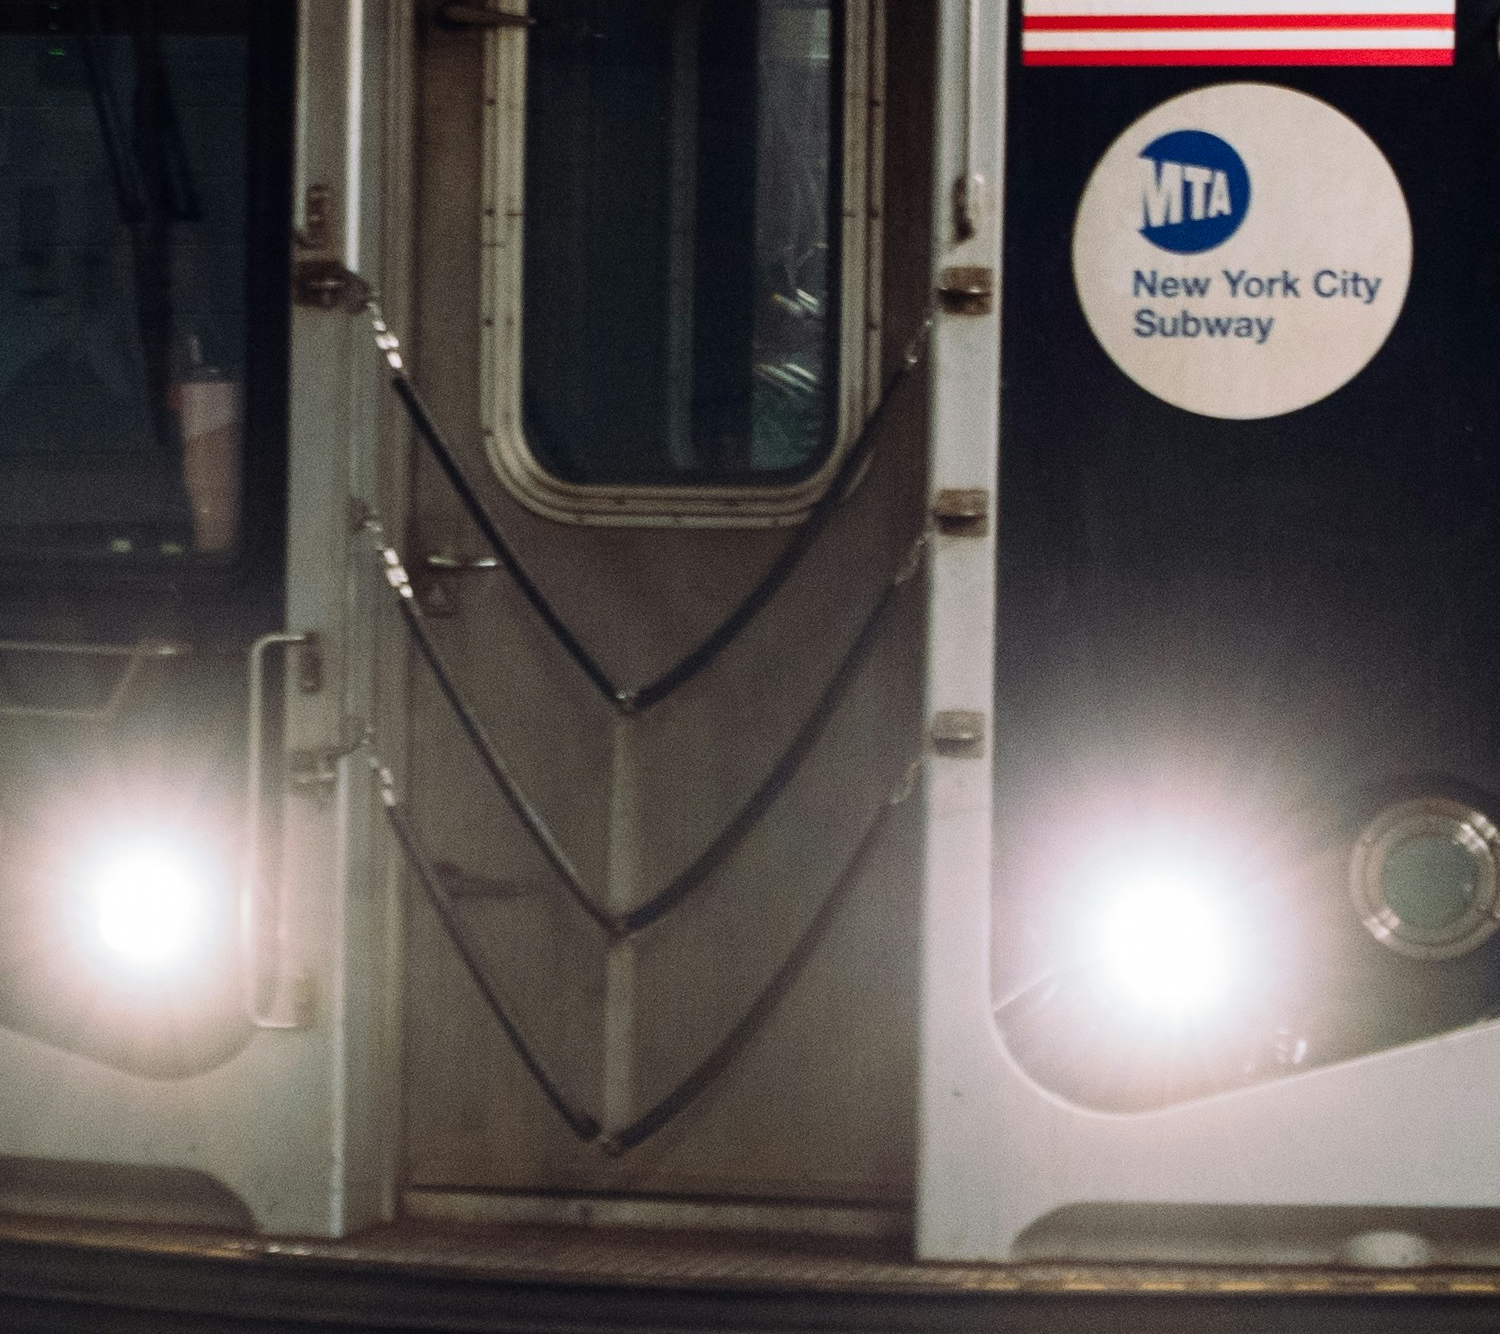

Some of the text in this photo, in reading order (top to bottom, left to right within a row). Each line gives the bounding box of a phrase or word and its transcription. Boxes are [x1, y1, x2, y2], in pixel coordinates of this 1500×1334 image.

[1138, 157, 1232, 228] MTA
[1132, 269, 1382, 304] New York City
[1133, 309, 1274, 345] Subway
